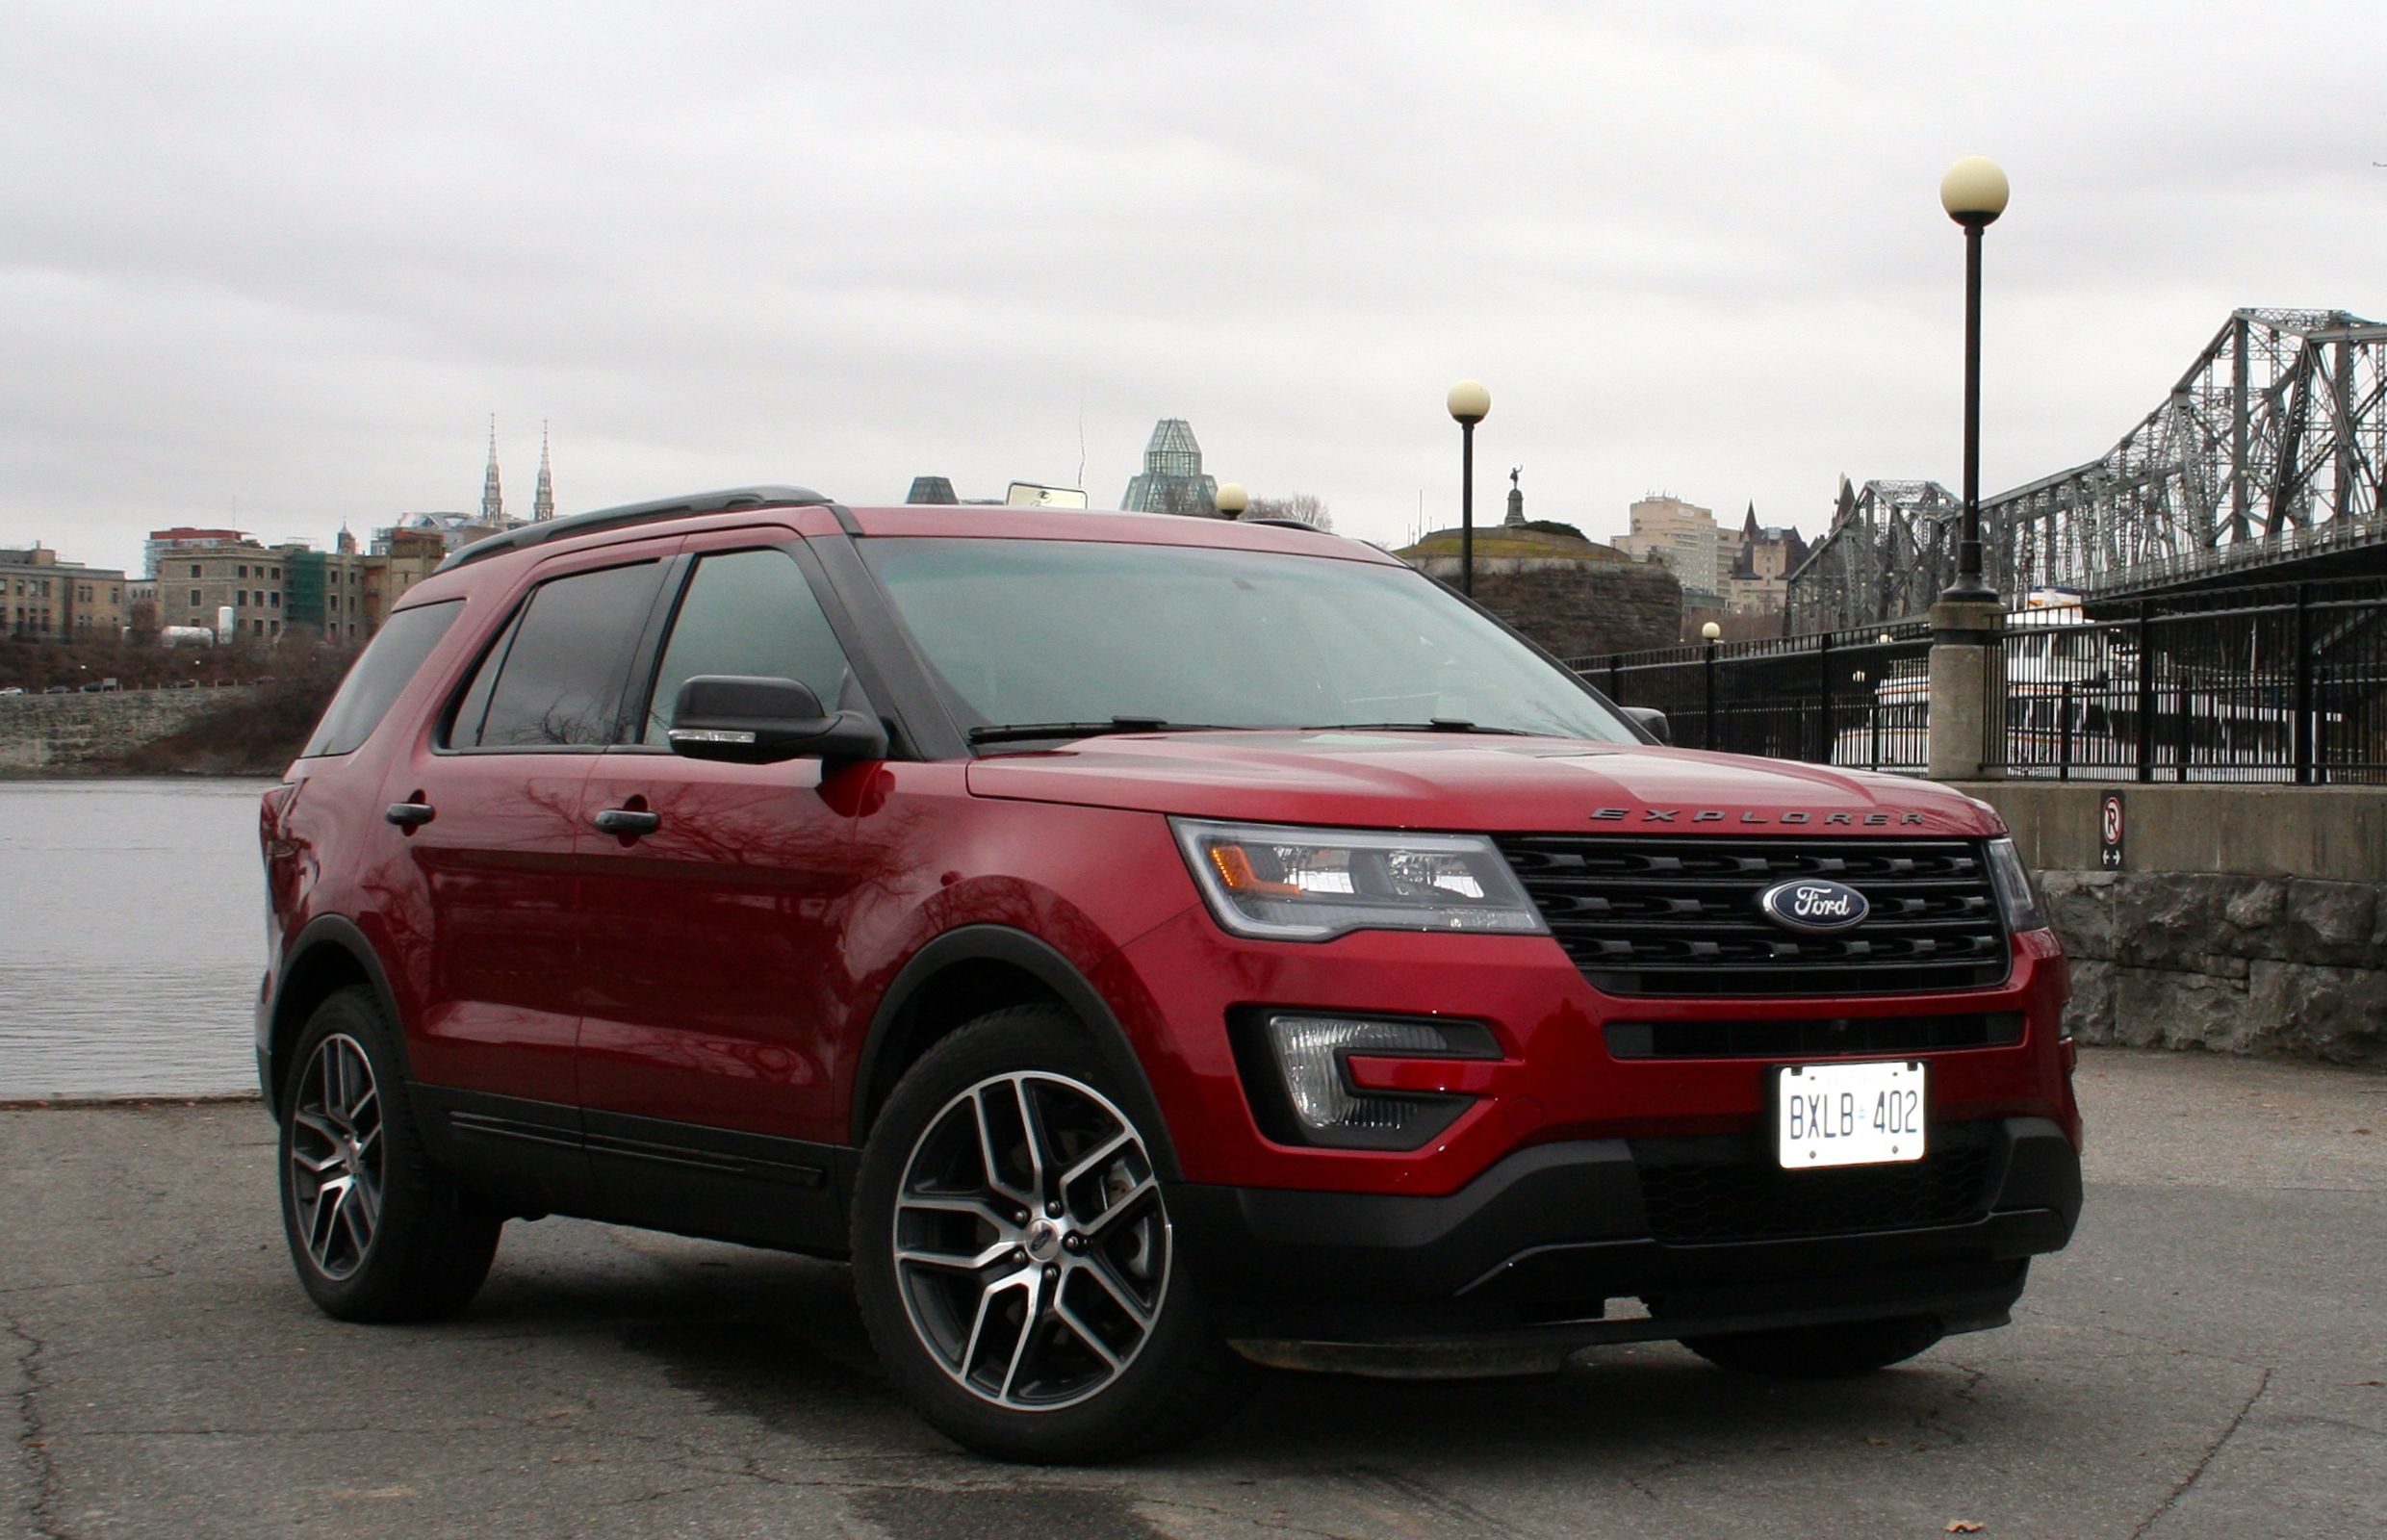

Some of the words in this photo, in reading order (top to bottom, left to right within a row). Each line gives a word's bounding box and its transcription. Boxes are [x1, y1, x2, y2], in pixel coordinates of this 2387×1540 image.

[1589, 808, 1923, 826] EXPLORER
[1794, 886, 1850, 915] Ford
[1790, 1092, 1854, 1140] BXLB
[1873, 1090, 1917, 1134] 402
